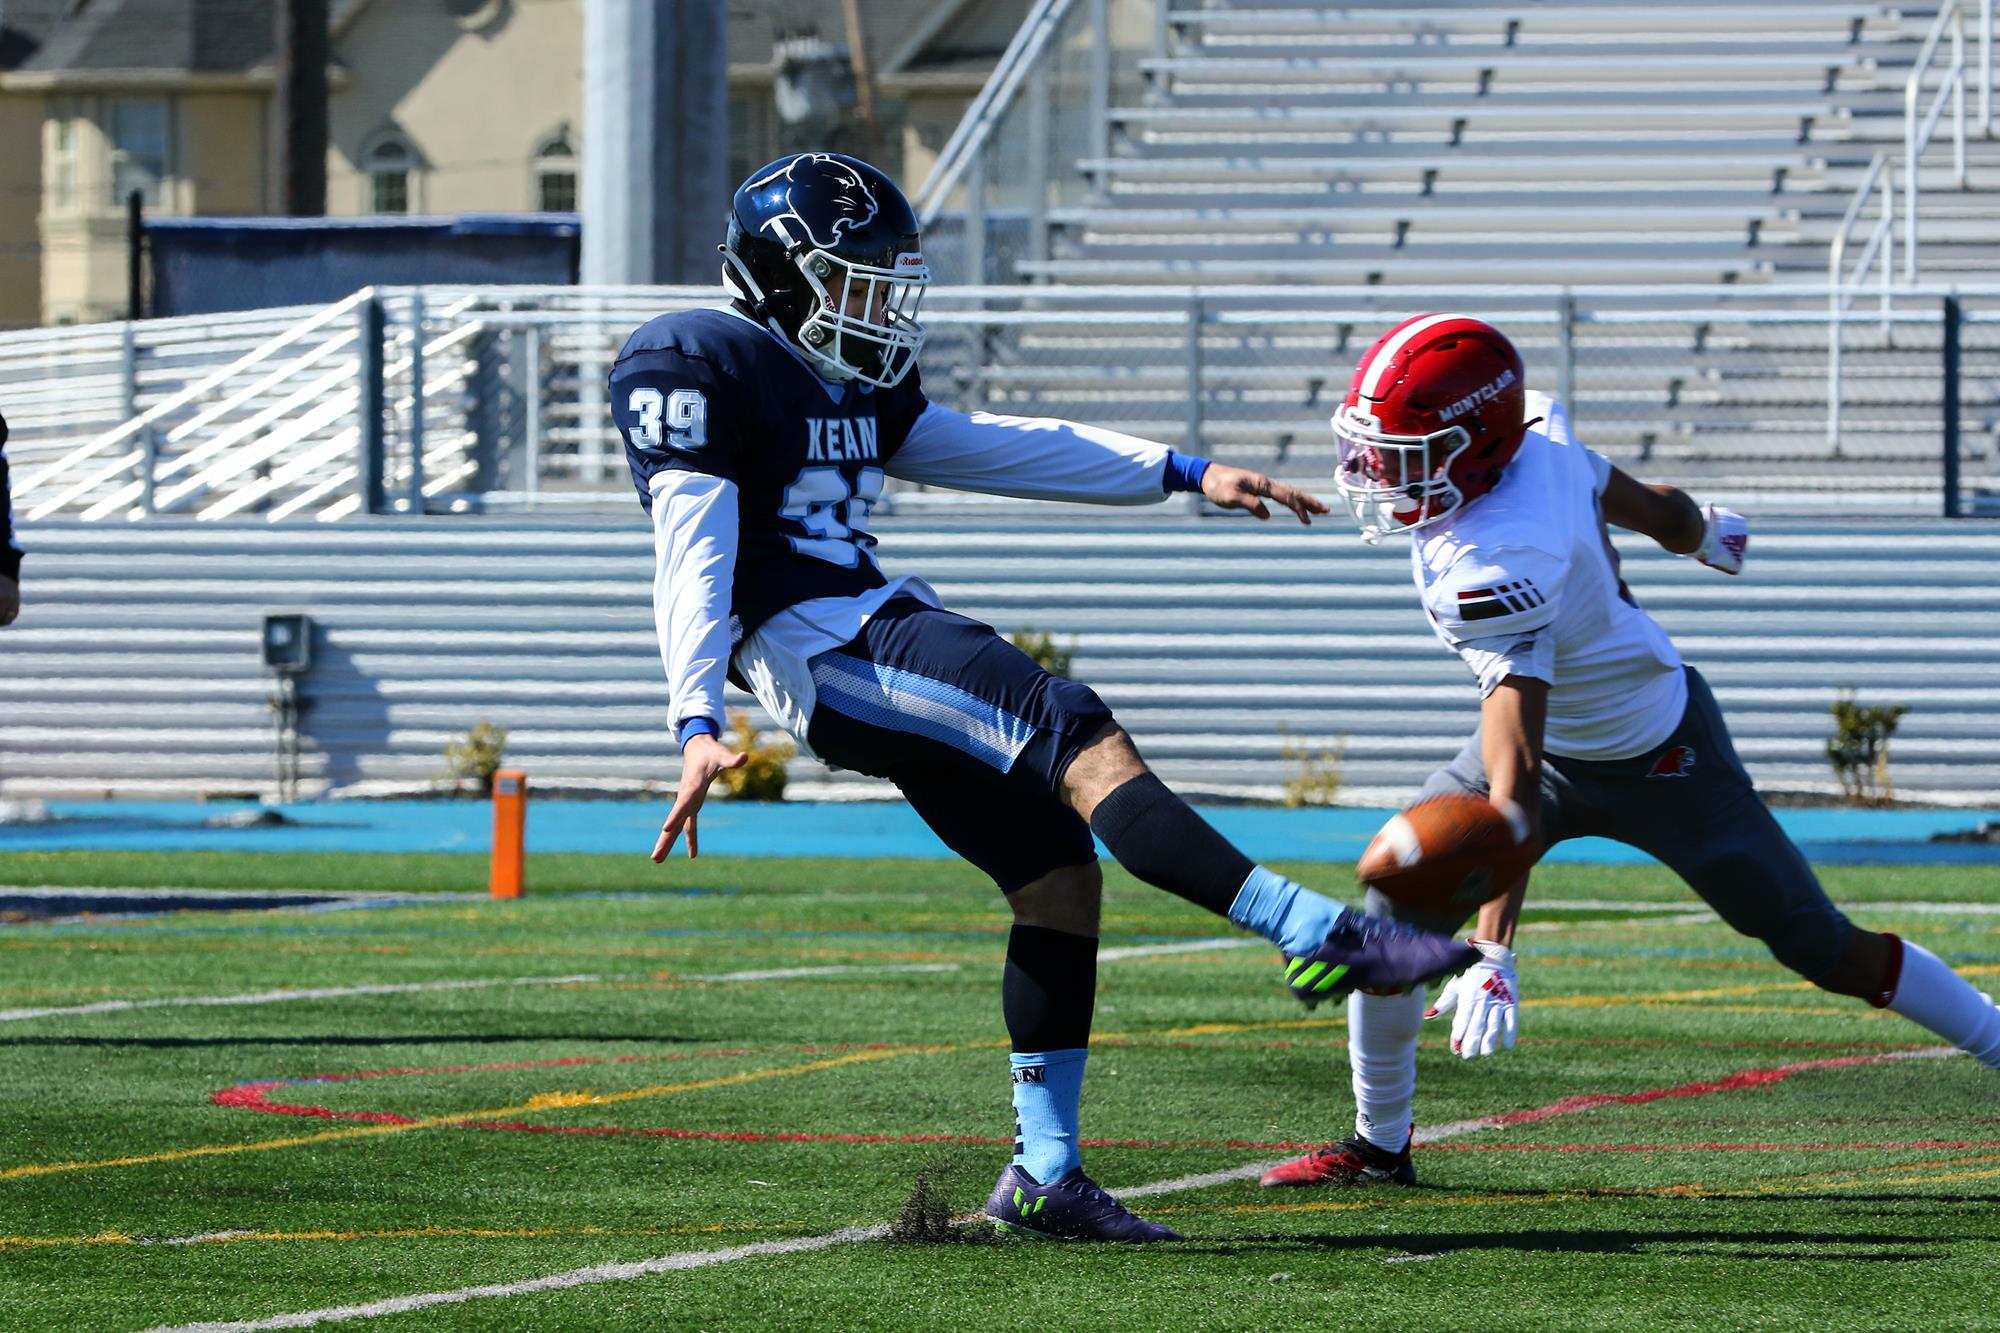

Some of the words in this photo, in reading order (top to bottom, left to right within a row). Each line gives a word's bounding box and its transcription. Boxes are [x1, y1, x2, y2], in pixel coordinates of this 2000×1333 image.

[628, 387, 709, 450] 39
[1438, 369, 1516, 422] MONTCLAIR
[805, 416, 879, 461] KEAN
